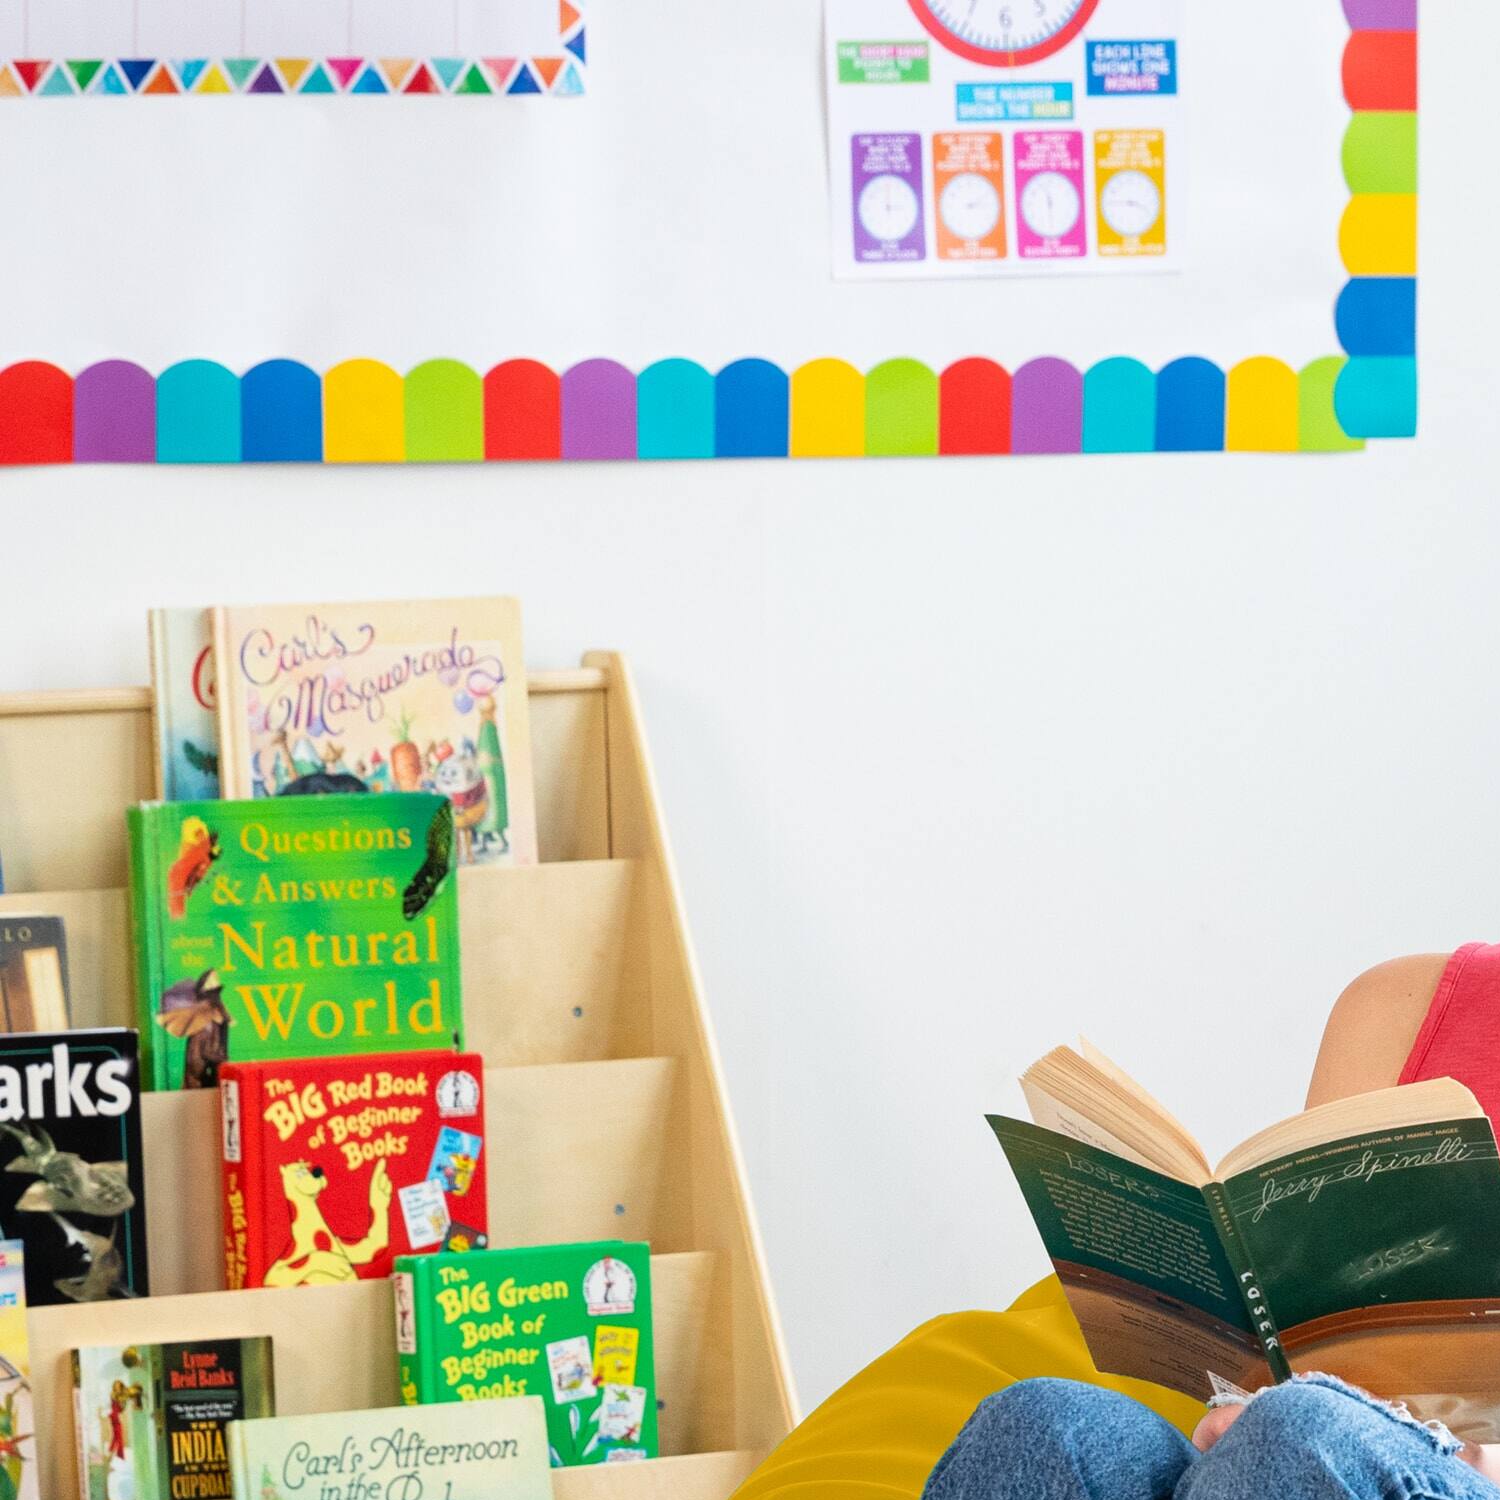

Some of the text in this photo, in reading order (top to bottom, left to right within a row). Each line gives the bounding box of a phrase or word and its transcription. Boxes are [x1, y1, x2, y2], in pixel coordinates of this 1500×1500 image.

[999, 6, 1013, 30] 6
[1132, 43, 1165, 58] LINE
[240, 615, 375, 686] Carl's
[264, 627, 505, 736] Masquerade
[240, 820, 412, 862] Questions
[211, 872, 397, 905] & Answers
[217, 915, 440, 972] Natural
[235, 978, 447, 1041] World
[0, 1042, 132, 1122] arks
[264, 1078, 295, 1098] The
[264, 1083, 328, 1142] BIG
[327, 1073, 373, 1107] Red
[376, 1072, 429, 1098] Book
[307, 1125, 326, 1148] of
[327, 1105, 423, 1144] Beginner
[340, 1131, 409, 1170] Books
[1360, 1136, 1393, 1148] AUTHOR
[1393, 1134, 1405, 1142] OF
[1406, 1130, 1434, 1140] MANIAC
[1435, 1127, 1459, 1136] MAGEE
[1252, 1136, 1475, 1224] Jerry Spinelli
[1211, 1189, 1236, 1238] SPINELLI
[438, 1266, 470, 1286] The
[436, 1282, 491, 1324] BIG
[497, 1277, 569, 1308] Green
[1240, 1271, 1280, 1352] LOSER
[459, 1313, 546, 1349] Book of
[170, 1368, 235, 1389] Reid Banks
[182, 1350, 218, 1369] Lynne
[441, 1347, 540, 1386] Beginner
[172, 1430, 226, 1465] INDIA
[282, 1428, 518, 1490] Carl's Afternoon
